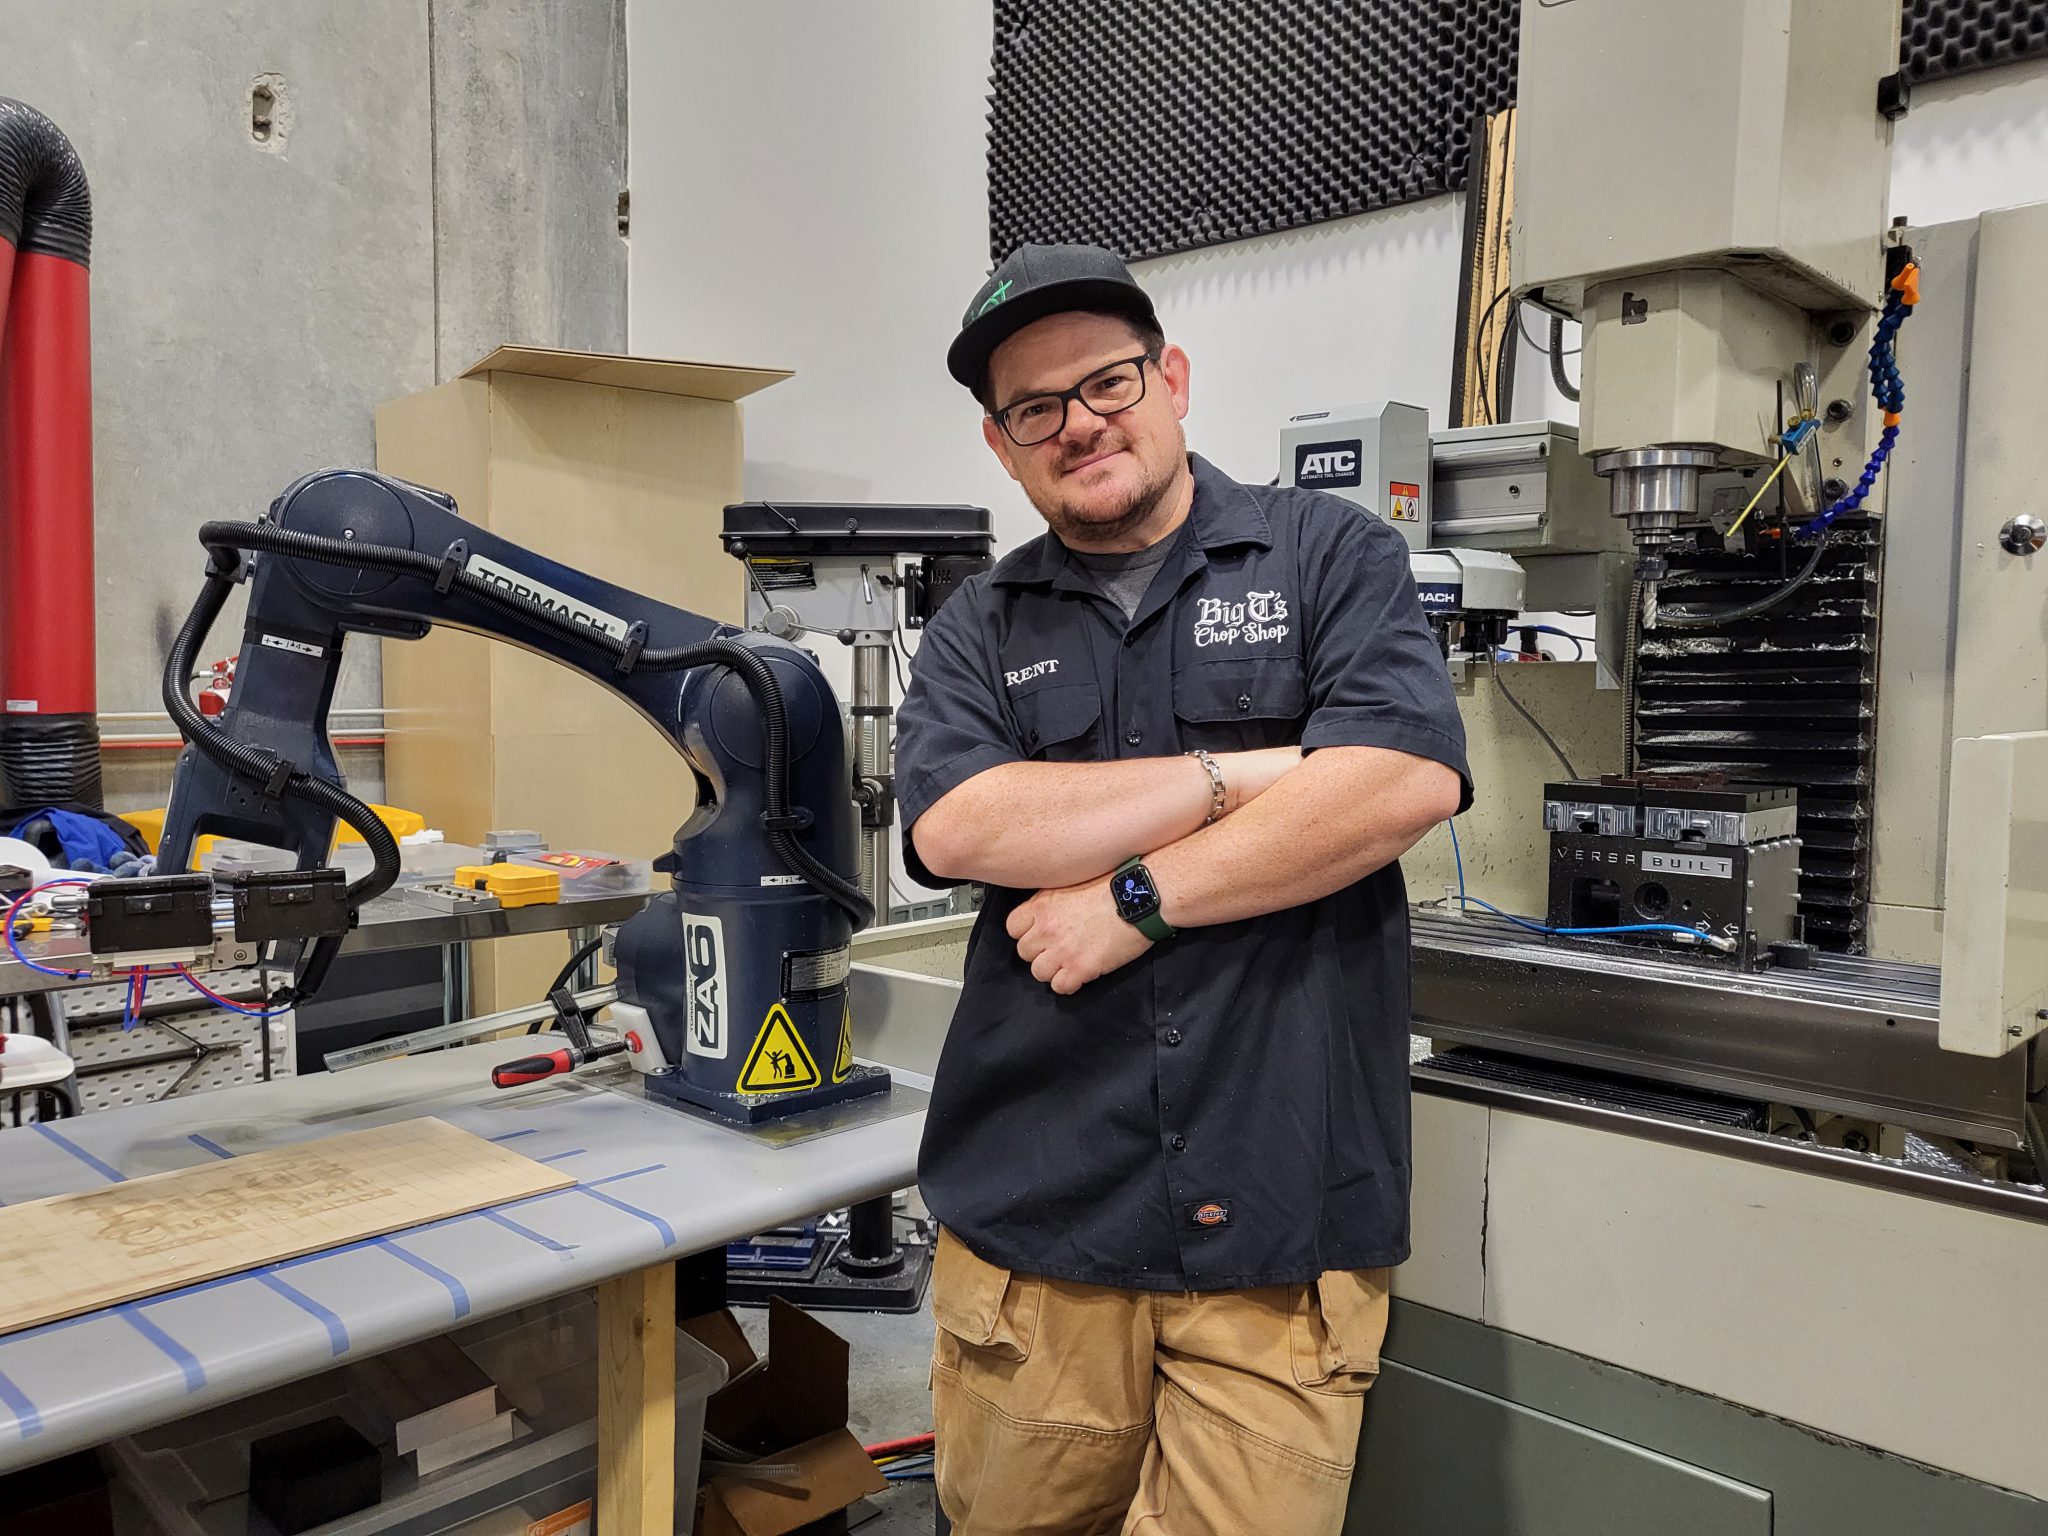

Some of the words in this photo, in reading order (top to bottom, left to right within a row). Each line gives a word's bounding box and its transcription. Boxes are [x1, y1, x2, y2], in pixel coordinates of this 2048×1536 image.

[1301, 450, 1355, 475] ATC
[1195, 597, 1246, 628] Big
[1246, 590, 1288, 622] T's
[1194, 625, 1240, 647] Chop
[1242, 622, 1289, 643] Shop
[1004, 660, 1059, 686] RENT
[1557, 847, 1636, 865] VERSA
[1652, 856, 1730, 872] BUILT
[687, 924, 718, 1049] ZA6
